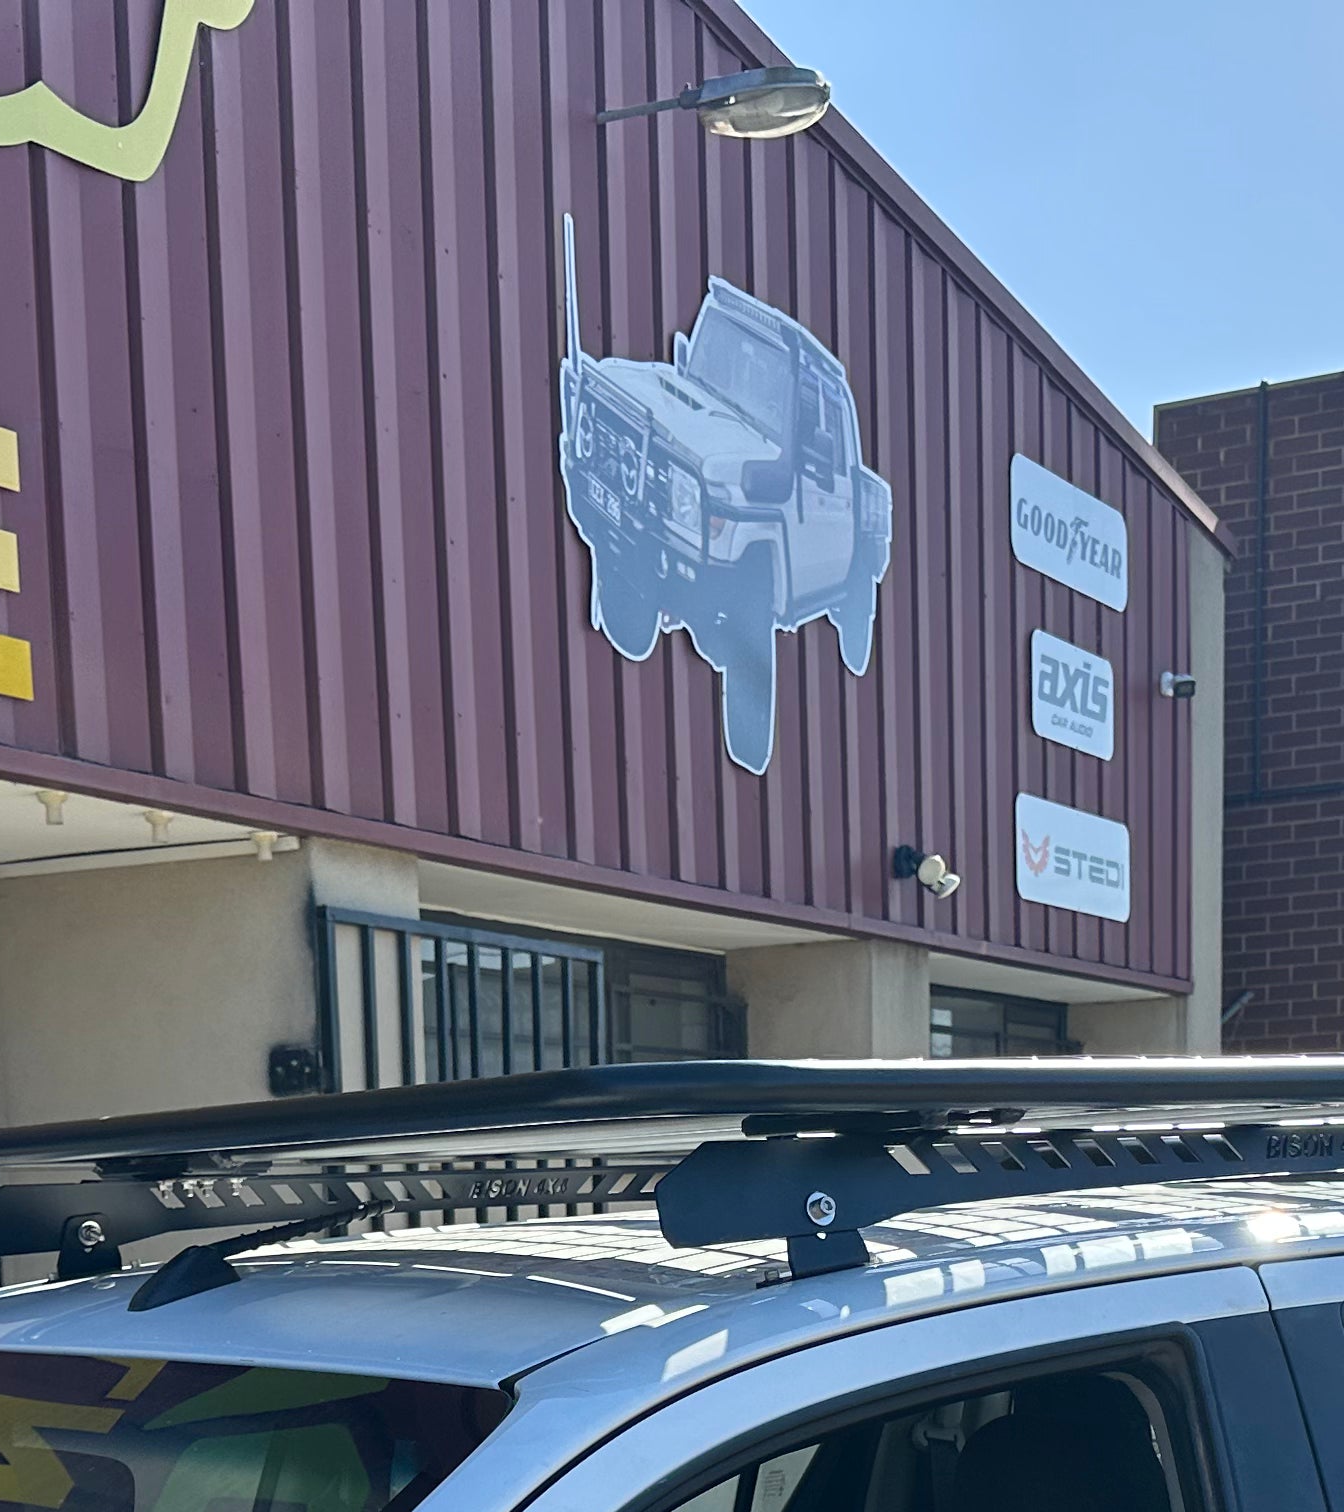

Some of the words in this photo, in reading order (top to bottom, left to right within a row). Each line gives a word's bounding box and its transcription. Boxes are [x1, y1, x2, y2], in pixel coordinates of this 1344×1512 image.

[1017, 497, 1123, 580] GOODYEAR
[1038, 654, 1110, 722] axis
[1051, 713, 1068, 729] CAR
[1069, 720, 1093, 738] AUDIO
[1054, 845, 1124, 890] STEDI
[1266, 1133, 1333, 1159] BISON
